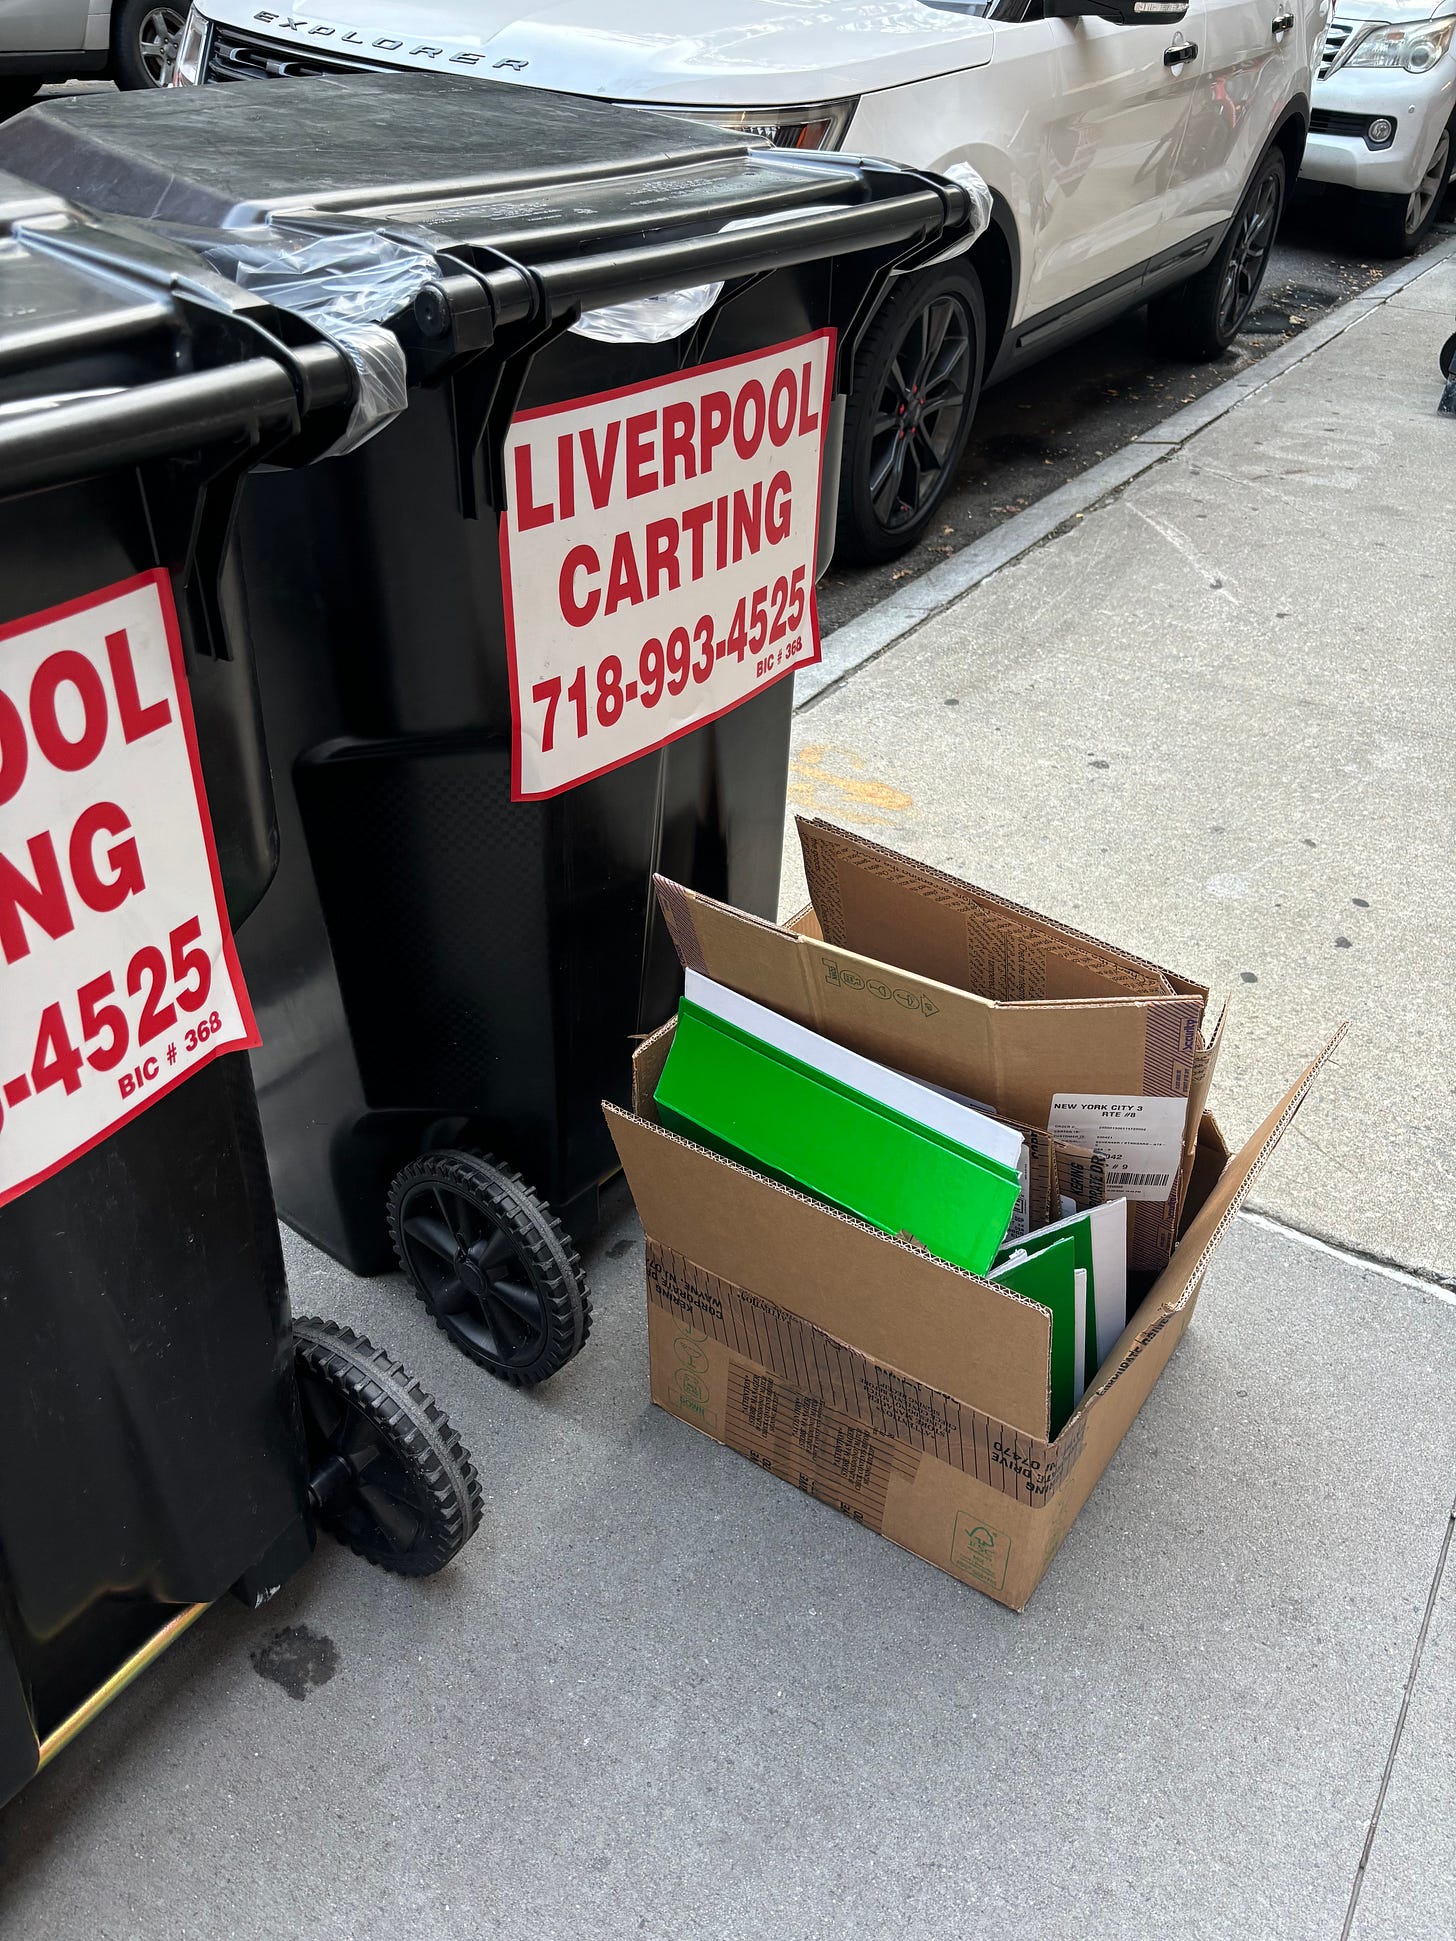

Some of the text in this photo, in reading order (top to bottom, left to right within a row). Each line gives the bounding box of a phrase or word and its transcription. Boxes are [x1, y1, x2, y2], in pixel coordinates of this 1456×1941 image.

[254, 10, 529, 71] EXPLORER
[514, 361, 818, 532] LIVERPOOL
[558, 470, 793, 627] CARTING
[533, 564, 806, 752] 718-993-4525
[756, 657, 774, 679] BIC
[776, 648, 783, 664] #
[0, 915, 212, 1134] -4525
[118, 1011, 223, 1101] BIC # 368
[1081, 1103, 1108, 1111] YORK
[1111, 1104, 1134, 1112] CITY
[1070, 1162, 1084, 1195] KERING
[646, 1258, 661, 1273] 07
[656, 1284, 692, 1312] KERING
[661, 1276, 723, 1320] CORPORATE
[991, 1453, 1030, 1477] DRIVE
[993, 1442, 1041, 1471] 07470
